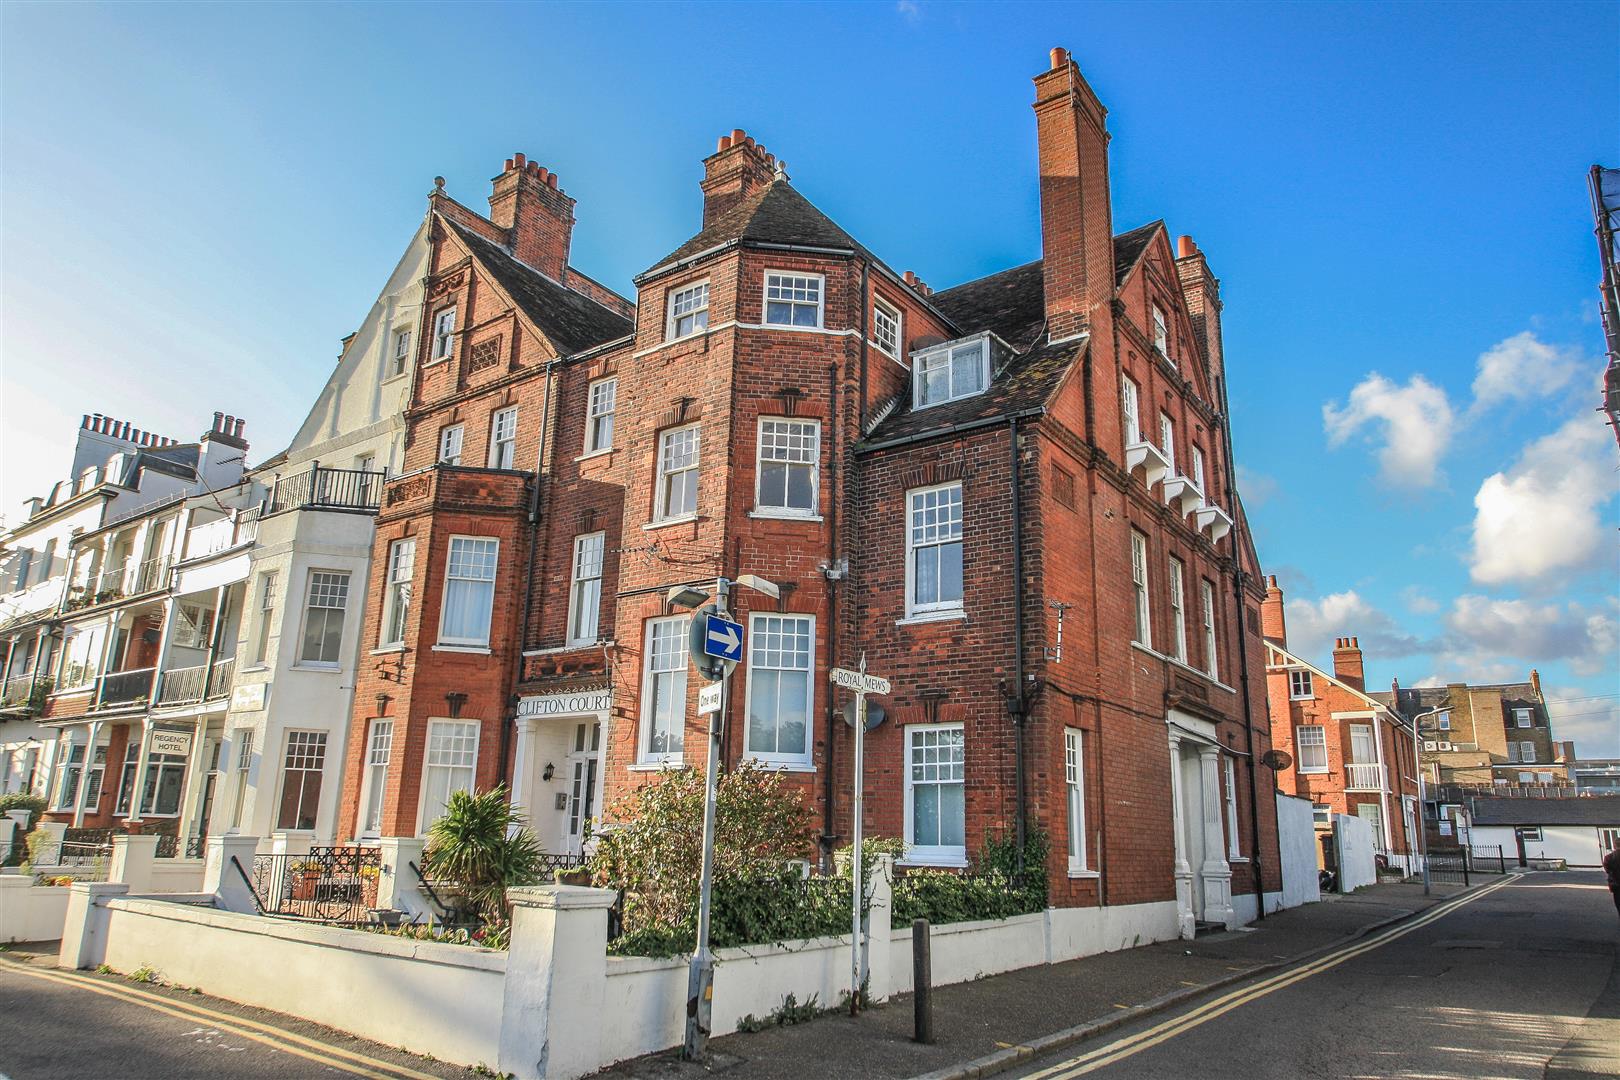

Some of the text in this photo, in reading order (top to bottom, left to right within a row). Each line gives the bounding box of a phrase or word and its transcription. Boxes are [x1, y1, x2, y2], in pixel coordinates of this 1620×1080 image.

[838, 672, 886, 692] ROYAL MEWS
[517, 695, 609, 716] CLIFTON COURT
[701, 692, 719, 707] One way
[154, 734, 189, 744] REGENCY
[158, 743, 183, 752] HOTEL
